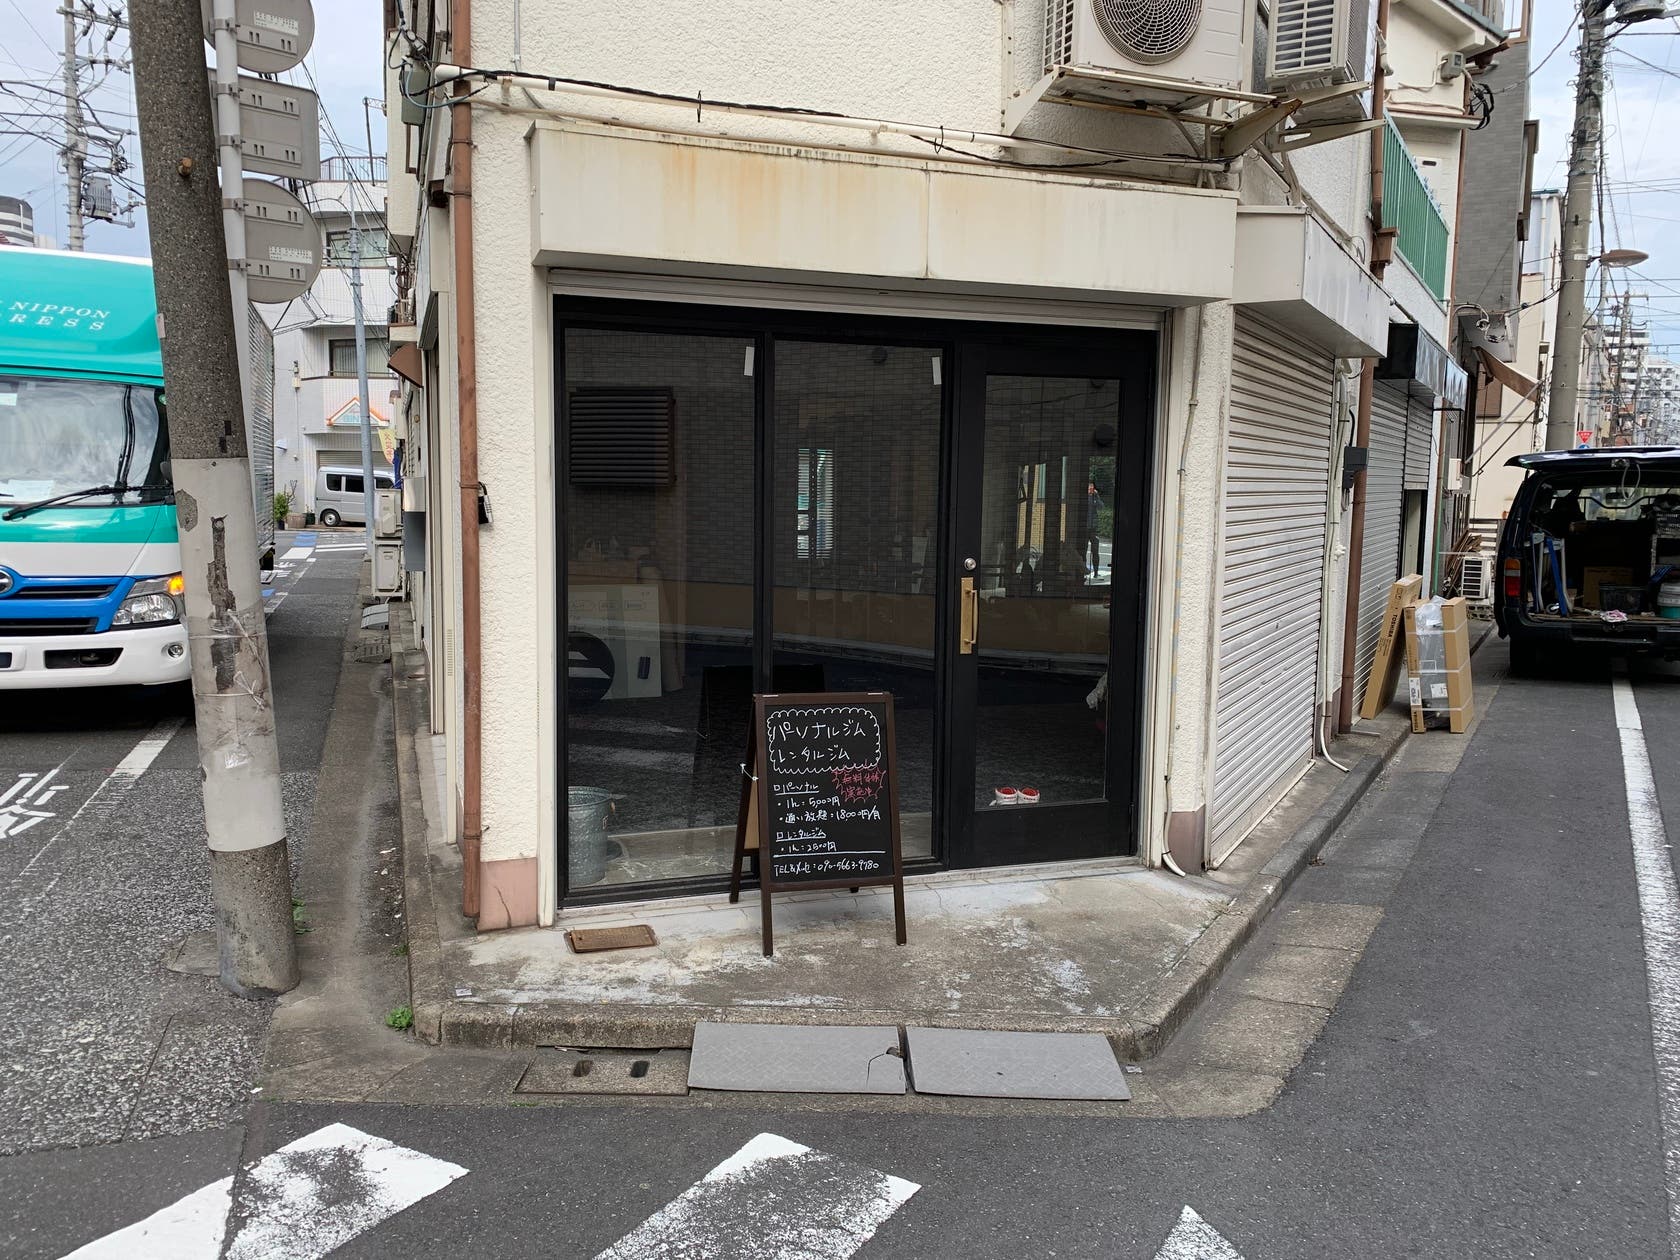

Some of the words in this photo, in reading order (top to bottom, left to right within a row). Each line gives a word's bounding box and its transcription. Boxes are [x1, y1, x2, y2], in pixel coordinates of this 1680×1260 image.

[8, 301, 110, 319] NIPPON
[8, 313, 105, 330] RESS
[1388, 614, 1398, 637] TOSHIBA
[772, 719, 866, 741] パーソナルジム
[778, 744, 850, 763] レンタルジム
